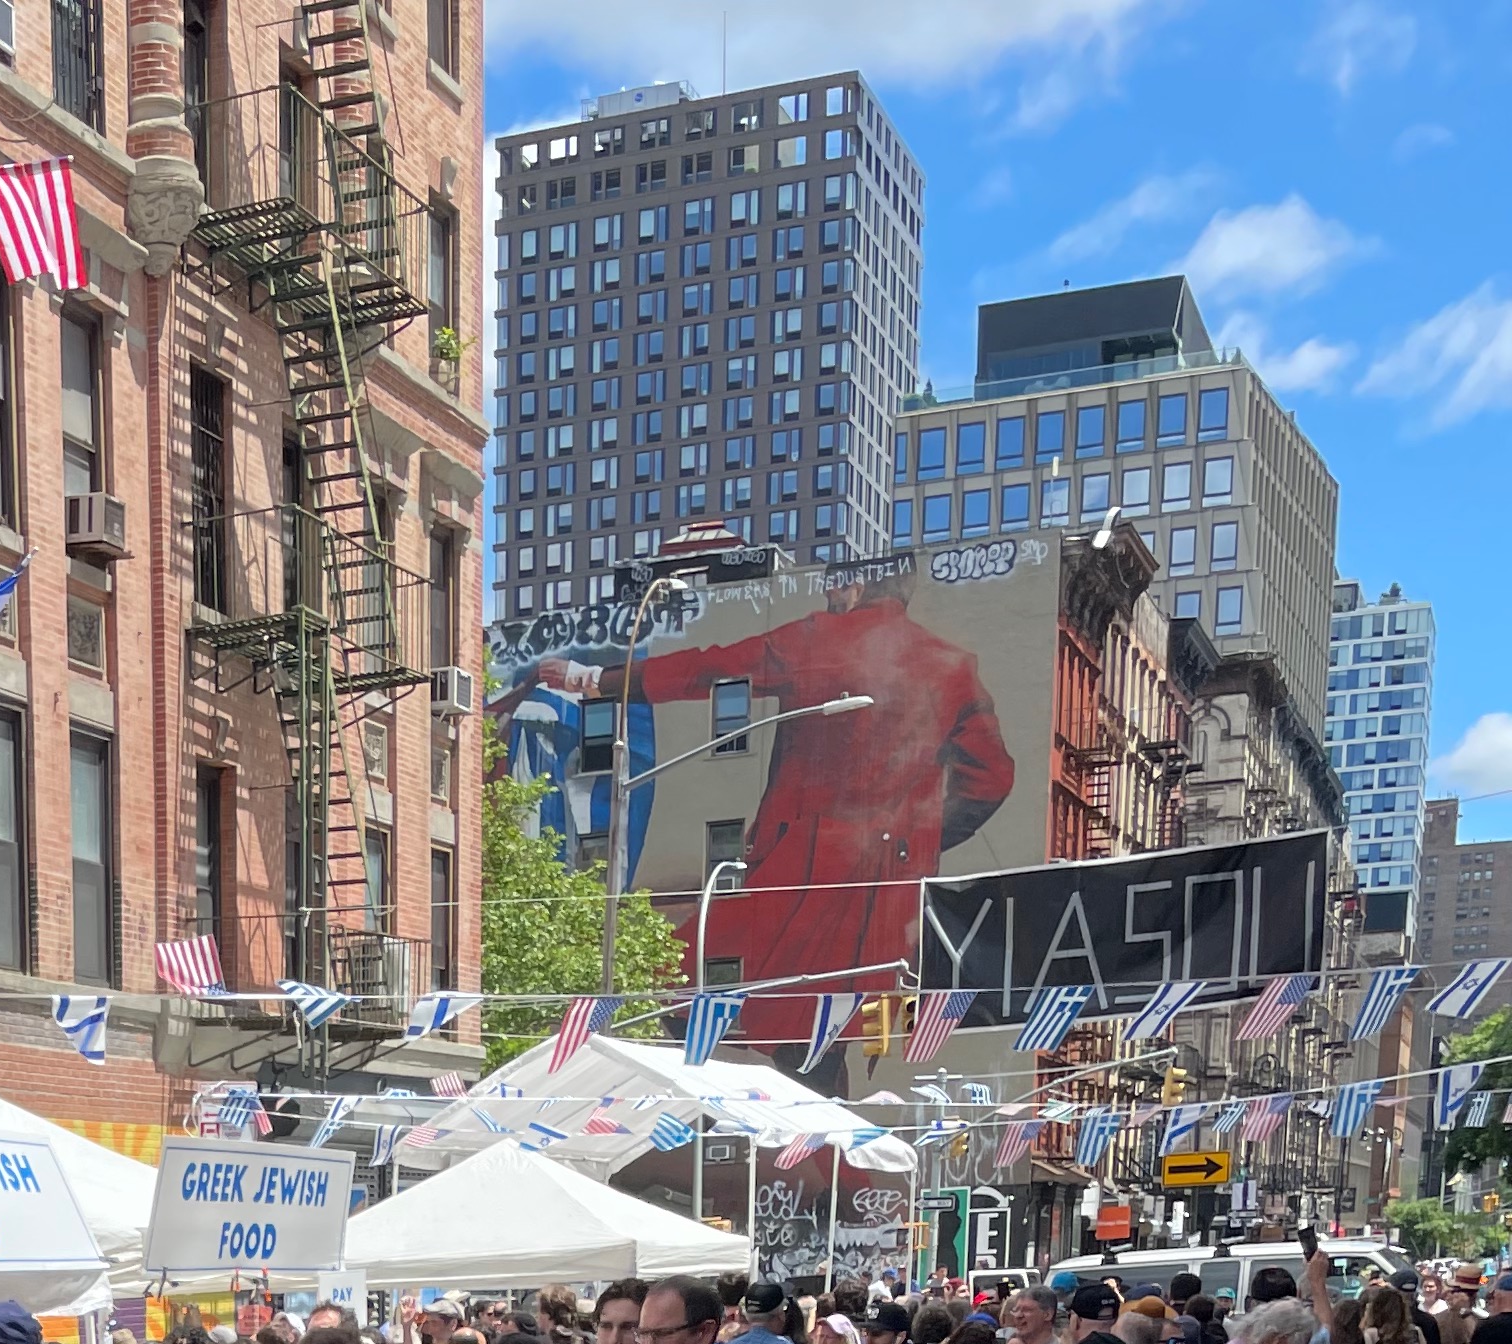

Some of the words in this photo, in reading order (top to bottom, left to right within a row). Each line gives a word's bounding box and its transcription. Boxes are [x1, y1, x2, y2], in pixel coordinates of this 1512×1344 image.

[707, 581, 771, 613] FLOWERS
[182, 1162, 249, 1203] GREEK
[253, 1166, 329, 1207] JEWISH
[218, 1222, 277, 1260] FOOD
[332, 1287, 352, 1302] PAY
